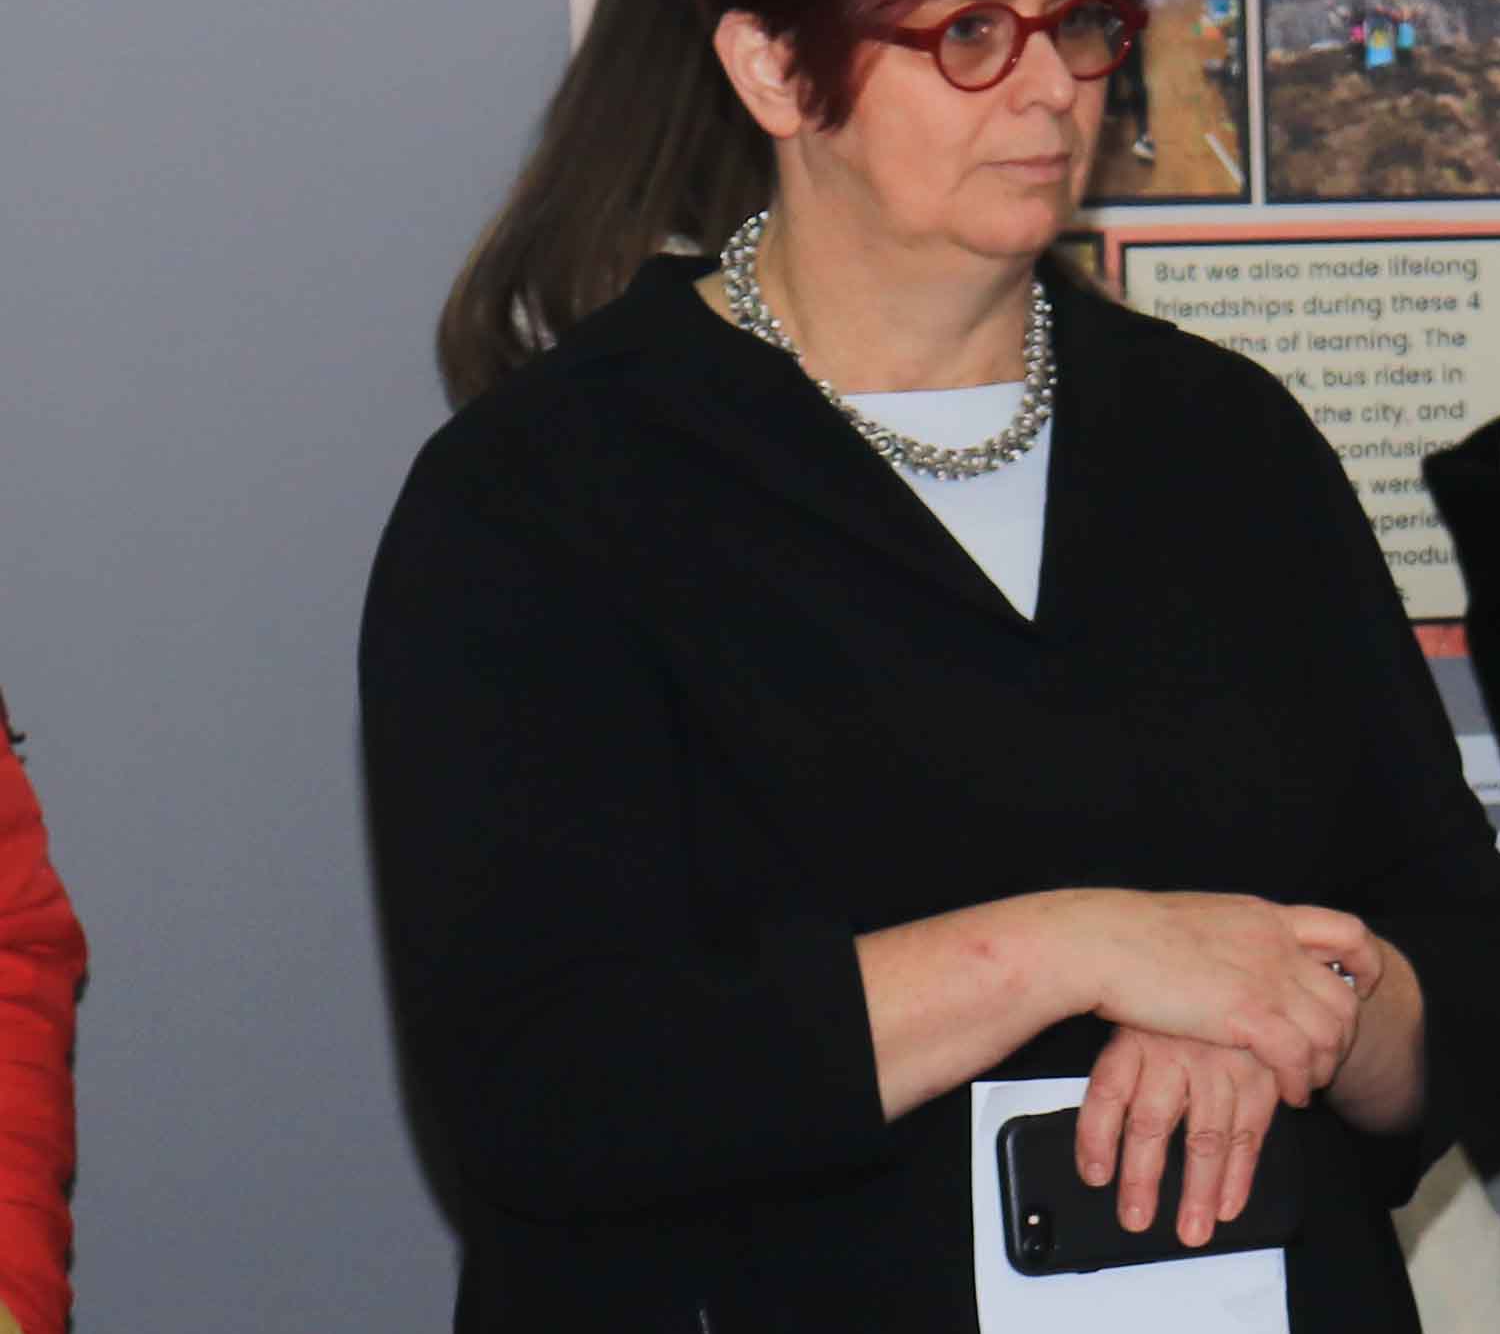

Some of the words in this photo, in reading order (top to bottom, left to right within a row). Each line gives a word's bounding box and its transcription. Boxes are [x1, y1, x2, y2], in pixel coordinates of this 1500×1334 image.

[1155, 263, 1195, 284] But
[1205, 265, 1239, 281] we
[1248, 260, 1298, 280] also
[1308, 258, 1378, 278] made
[1388, 255, 1479, 280] lifelong
[1154, 295, 1293, 322] friendships
[1303, 294, 1381, 320] during
[1391, 293, 1457, 314] these
[1466, 293, 1481, 311] 4
[1277, 332, 1298, 352] of
[1307, 329, 1412, 357] learning.
[1424, 328, 1465, 349] The
[1323, 365, 1366, 387] bus
[1374, 364, 1432, 385] rides
[1442, 363, 1462, 383] in
[1314, 402, 1352, 423] the
[1361, 400, 1410, 427] city,
[1418, 399, 1464, 421] and
